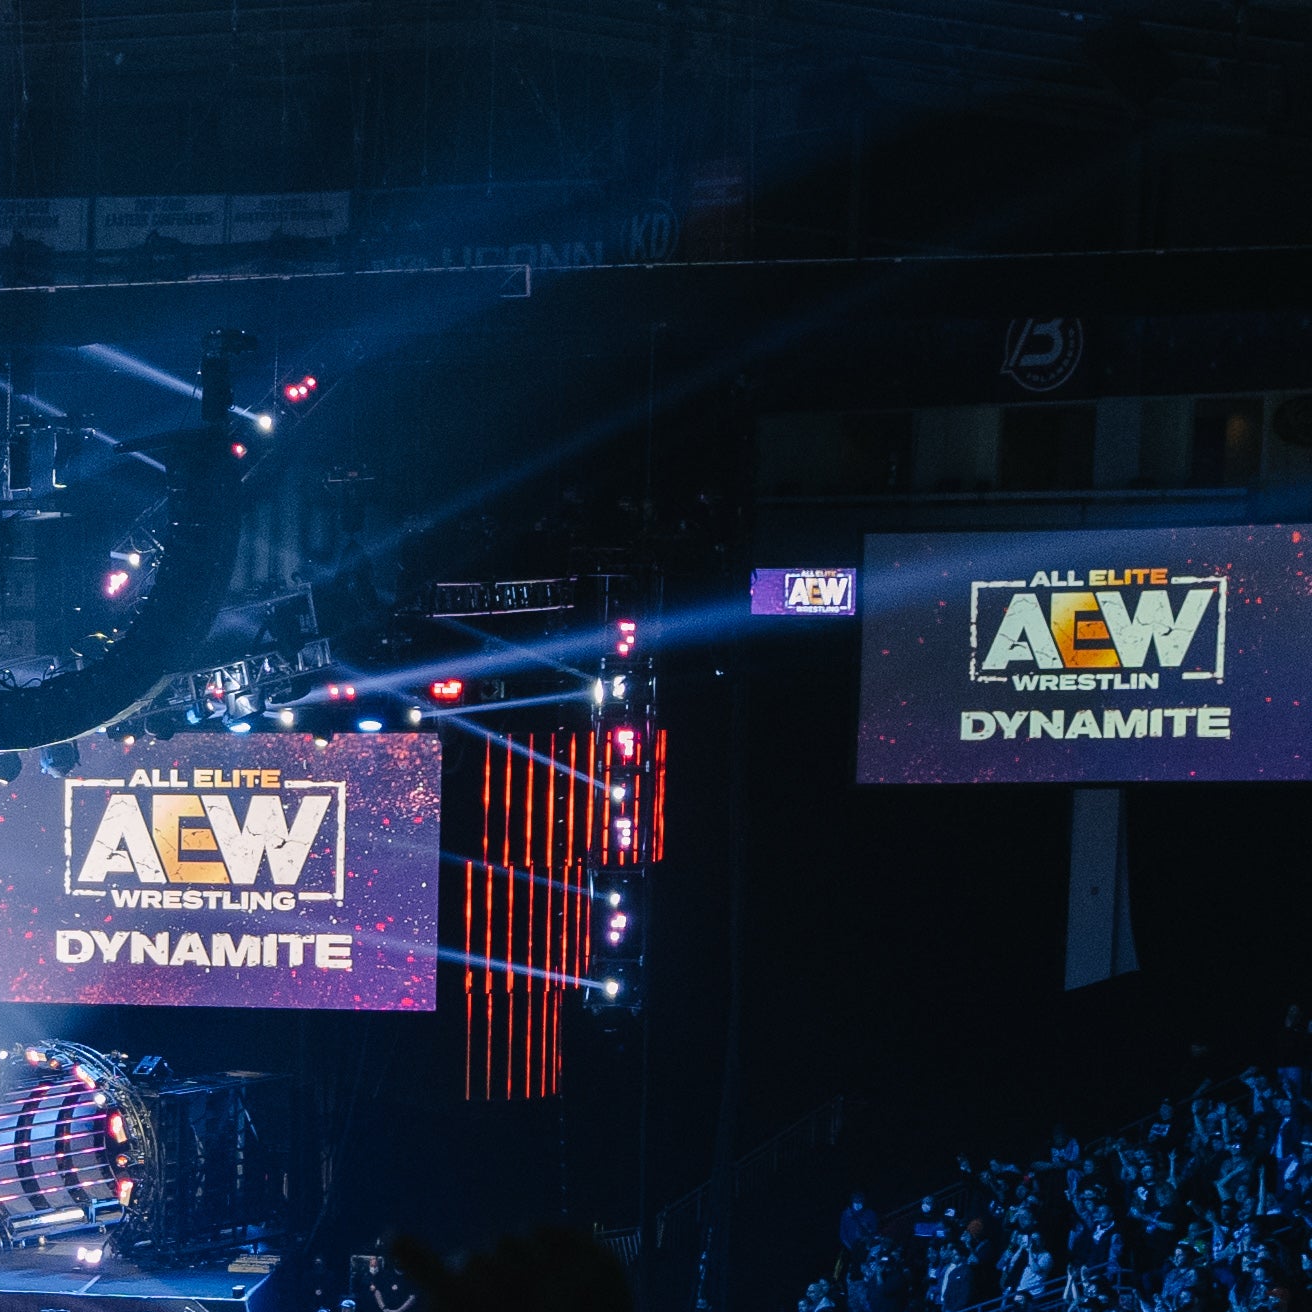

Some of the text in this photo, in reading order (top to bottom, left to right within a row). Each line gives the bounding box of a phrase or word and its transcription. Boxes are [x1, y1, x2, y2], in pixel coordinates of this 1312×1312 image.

[1029, 567, 1168, 588] ALL ELITE
[789, 578, 849, 605] AEW
[982, 589, 1213, 670] AEW
[1013, 673, 1159, 692] WRESTLIN
[960, 706, 1232, 742] DYNAMITE
[128, 769, 281, 789] ALL ELITE
[77, 794, 333, 885] AEW
[111, 889, 296, 912] WRESTLING
[55, 929, 353, 970] DYNAMITE
